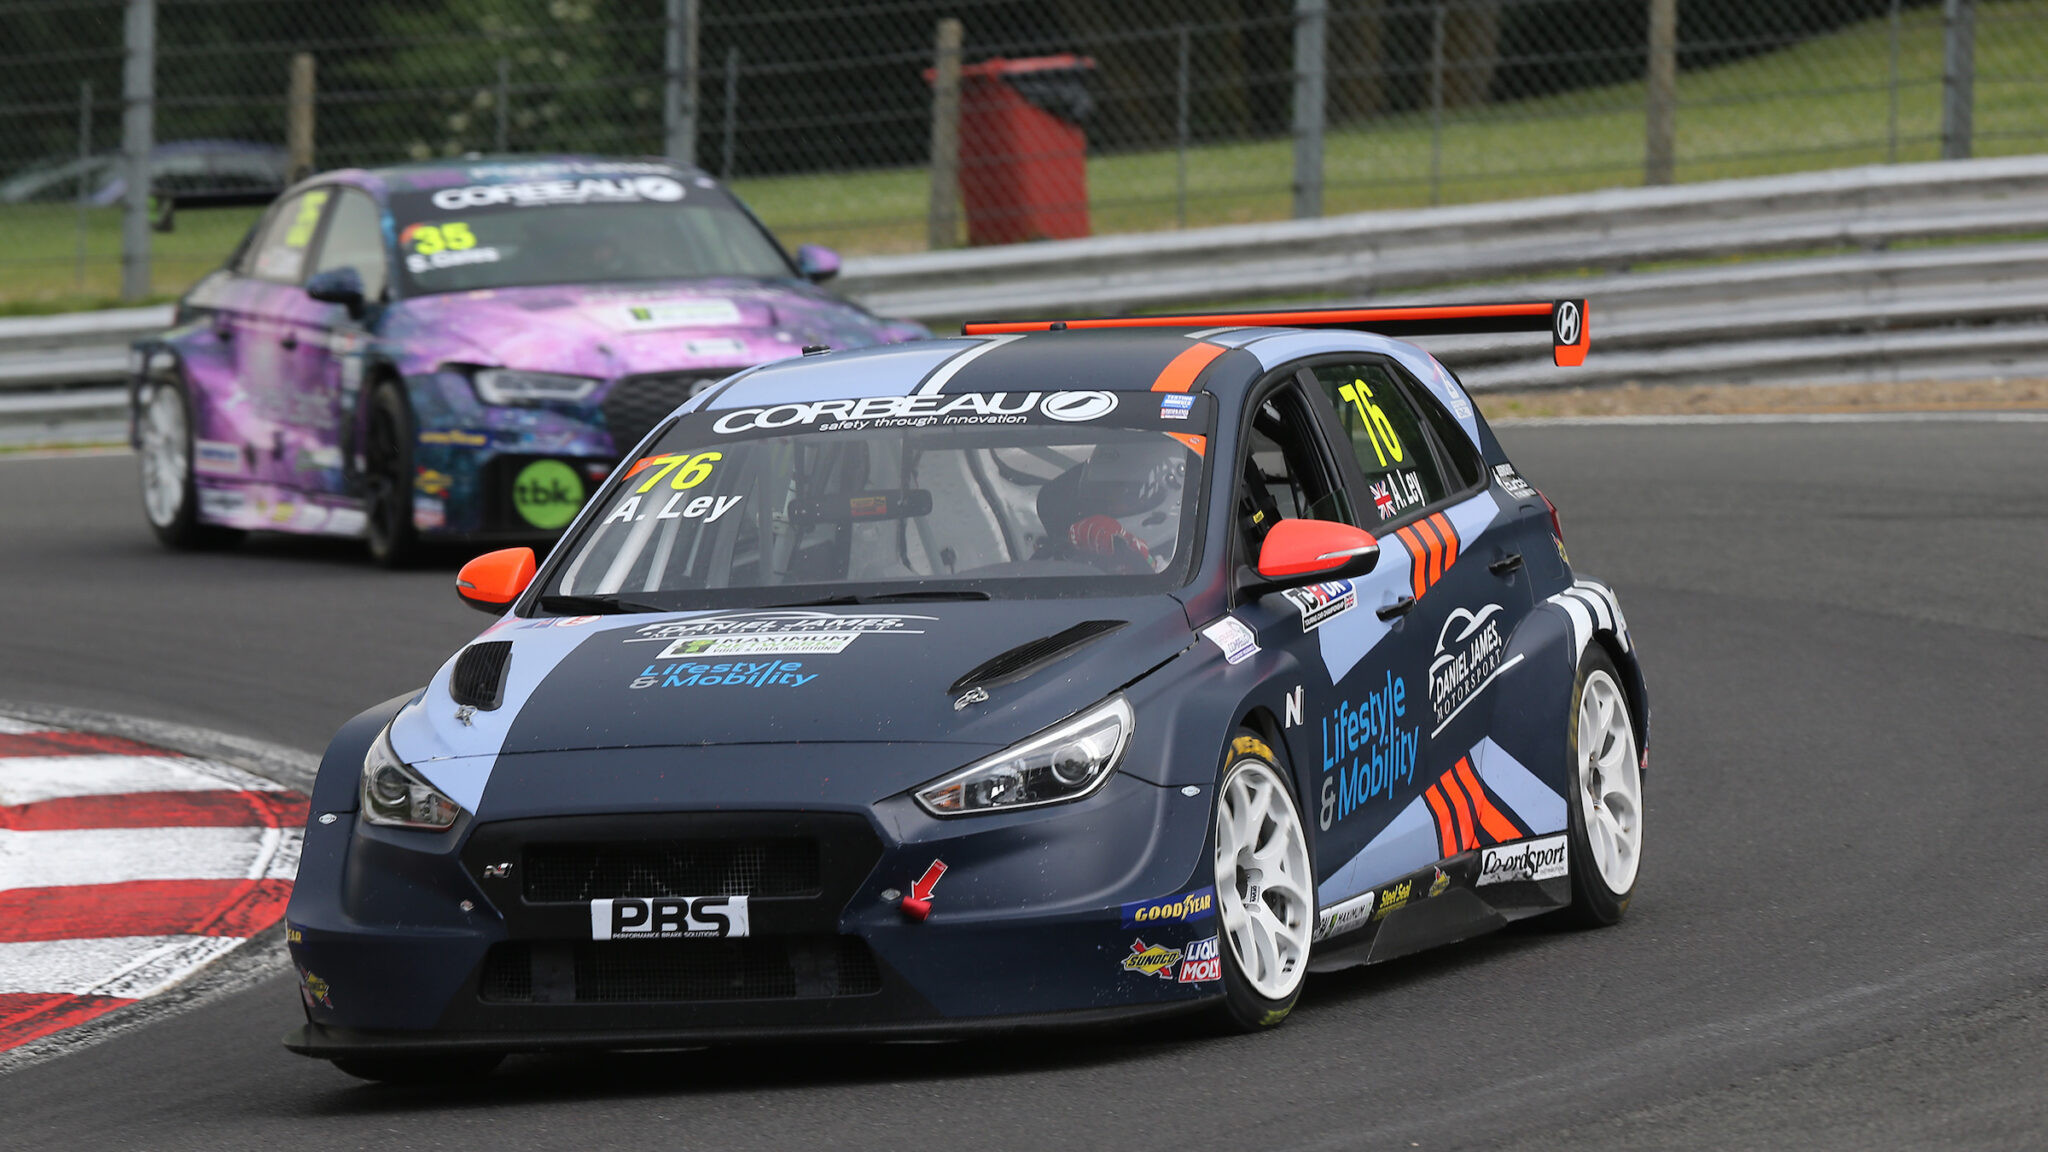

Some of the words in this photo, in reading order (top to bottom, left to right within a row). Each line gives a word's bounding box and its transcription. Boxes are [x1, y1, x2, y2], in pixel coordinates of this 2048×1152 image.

[432, 178, 635, 210] CORBEAU
[411, 222, 477, 255] 35
[712, 391, 1042, 434] CORBEAU
[819, 420, 870, 432] safety
[874, 415, 938, 428] through
[942, 414, 1028, 425] innovation
[1337, 378, 1404, 468] 76
[635, 451, 723, 494] 76
[1395, 468, 1426, 508] Ley
[602, 495, 646, 525] A.
[656, 491, 743, 524] Ley
[1386, 473, 1408, 511] A.
[656, 620, 778, 634] DANIEL
[722, 634, 851, 644] MAXIMUM
[629, 676, 659, 690] &
[661, 672, 820, 689] Mobility
[640, 659, 803, 677] Lifestyle
[1436, 650, 1469, 704] DANIEL
[1436, 648, 1501, 724] MOTORSPORT
[1322, 669, 1406, 773] Lifestyle
[1319, 776, 1336, 832] &
[1338, 725, 1420, 822] Mobility
[612, 896, 731, 938] PBS
[1135, 893, 1212, 922] GOODYEAR
[613, 931, 660, 939] PERFORMANCE
[683, 930, 720, 938] SOLUTIONS
[1127, 951, 1179, 967] SUNOCO
[1182, 958, 1220, 980] MOLY
